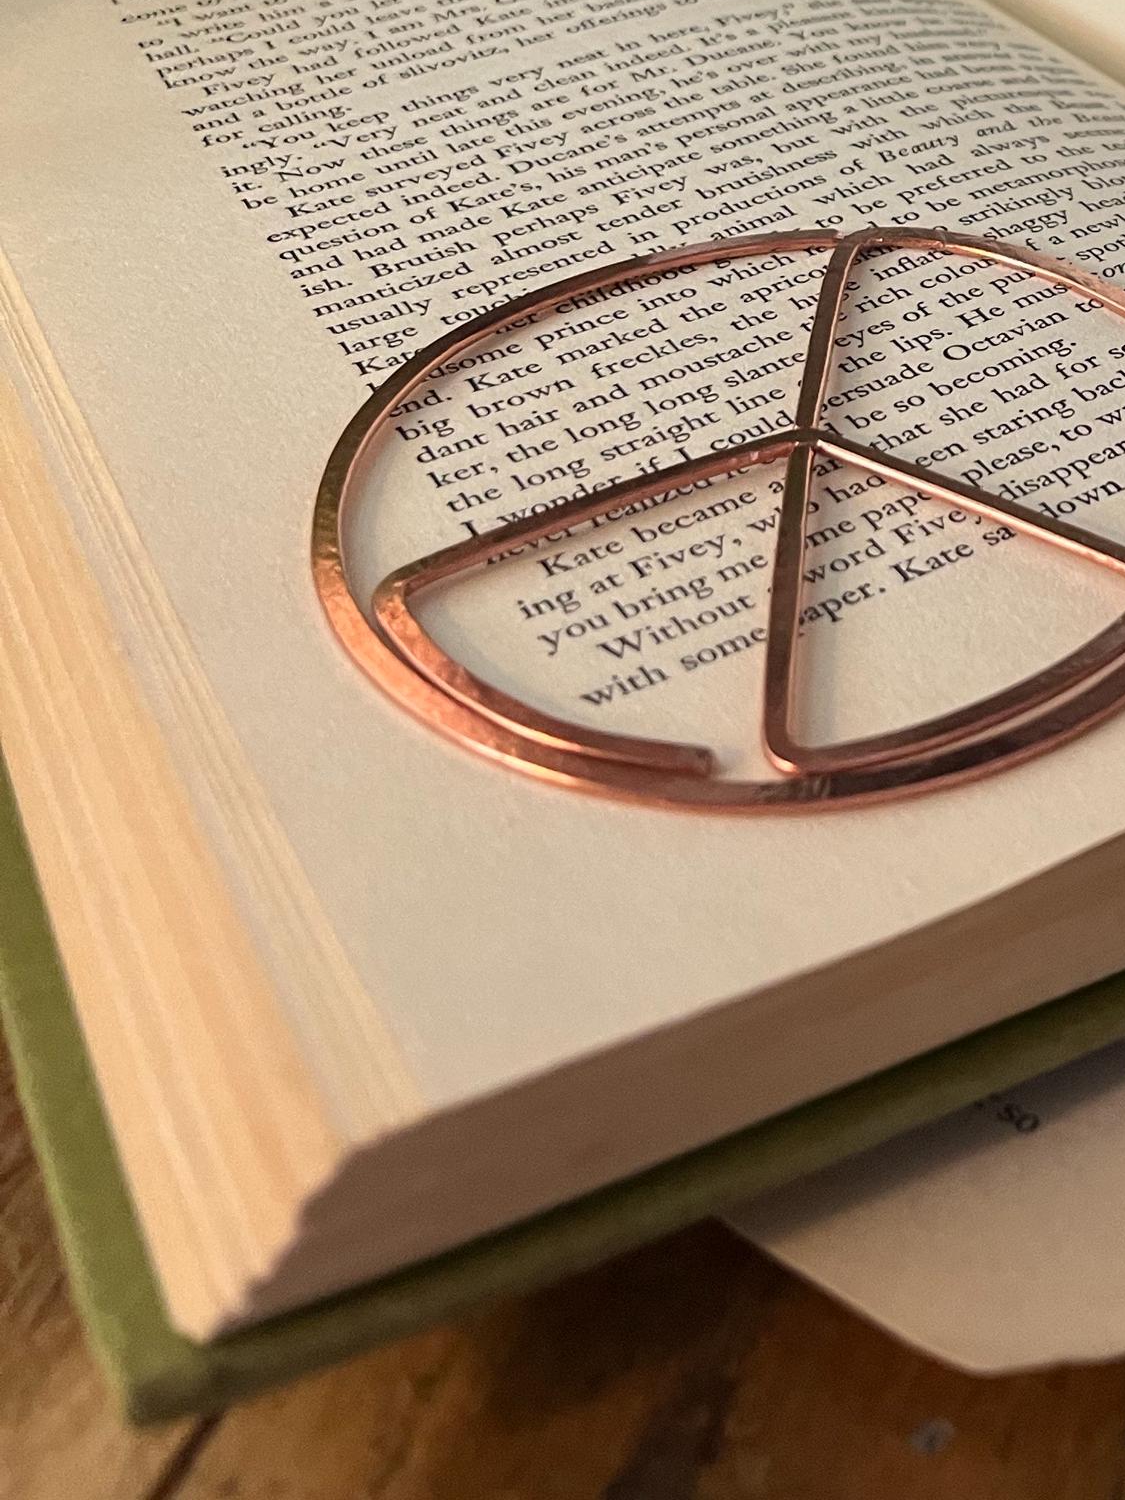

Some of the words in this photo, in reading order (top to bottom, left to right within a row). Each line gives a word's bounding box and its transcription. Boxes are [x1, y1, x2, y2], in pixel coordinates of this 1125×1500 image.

[201, 130, 244, 148] for
[258, 107, 353, 135] calling.
[266, 200, 392, 242] expected
[400, 171, 500, 206] indeed.
[505, 134, 627, 174] Ducane’s
[636, 100, 741, 136] attempts
[749, 91, 774, 103] at
[781, 62, 907, 93] describing,
[312, 261, 474, 317] manticized
[490, 231, 583, 265] almost
[595, 199, 683, 231] tender
[694, 150, 837, 199] brutishness
[848, 128, 909, 149] with
[919, 109, 994, 129] which
[325, 297, 432, 334] usually
[451, 240, 616, 299] represented
[626, 230, 659, 244] in
[670, 174, 827, 235] productions
[839, 158, 866, 175] of
[877, 134, 958, 163] Beauty
[976, 120, 1017, 137] and
[1027, 115, 1061, 127] the
[537, 614, 609, 656] you
[611, 575, 713, 619] bring
[716, 554, 768, 582] me
[959, 438, 1061, 489] please,
[1058, 423, 1092, 441] to
[579, 665, 668, 705] with
[680, 624, 770, 672] some
[797, 582, 885, 628] aper.
[888, 543, 974, 583] Kate
[978, 523, 1021, 550] sa
[595, 595, 755, 658] Without
[802, 538, 887, 584] word
